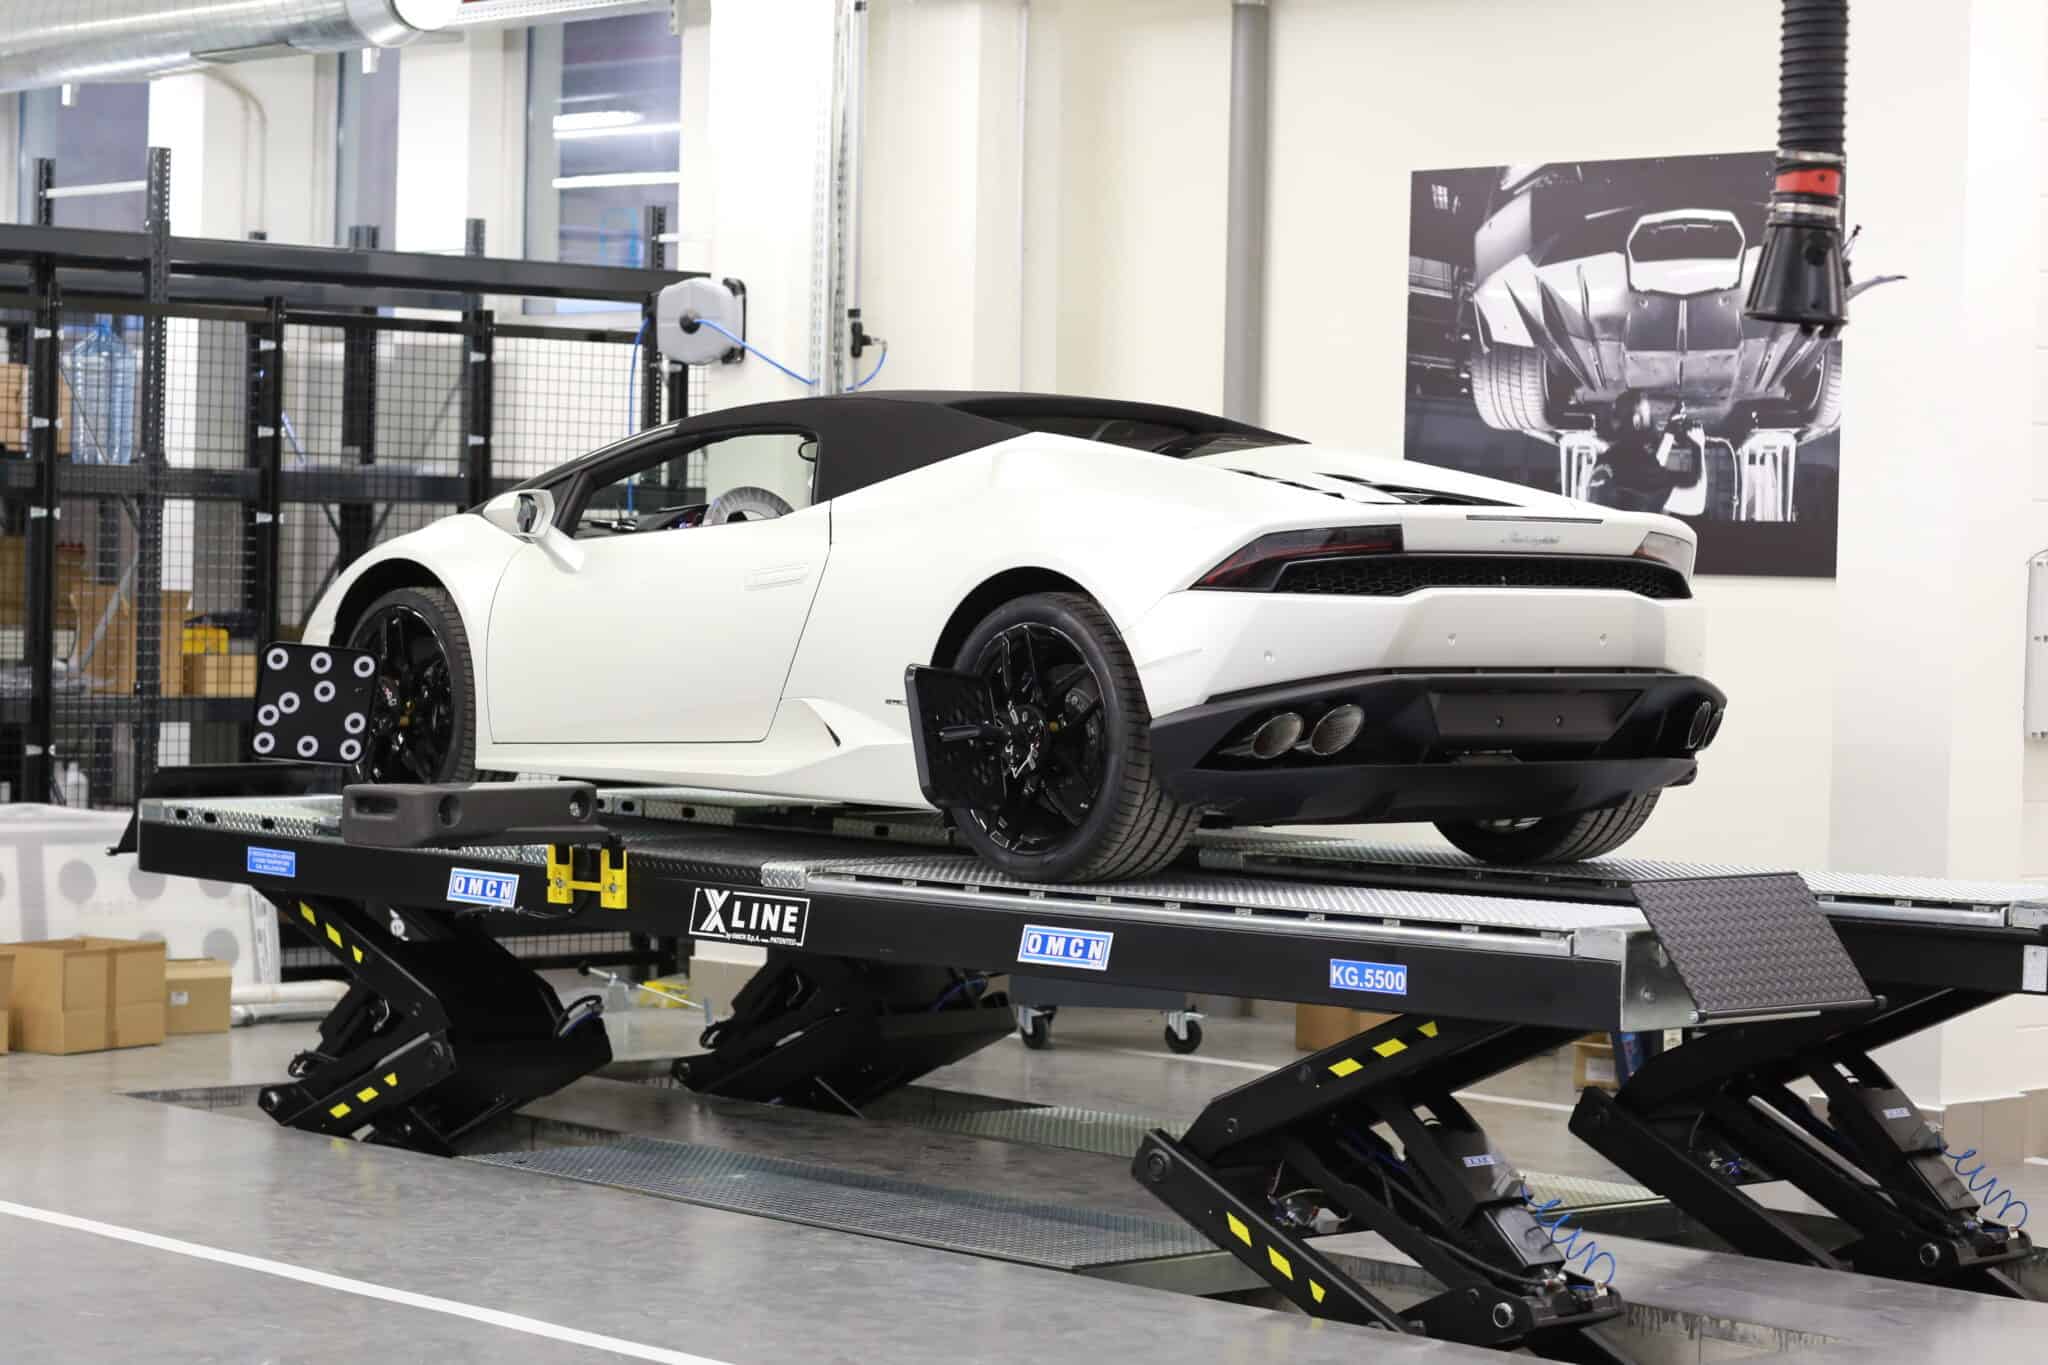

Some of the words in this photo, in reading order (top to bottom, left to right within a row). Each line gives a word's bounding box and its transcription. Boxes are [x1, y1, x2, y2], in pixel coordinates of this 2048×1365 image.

[454, 876, 512, 899] OMCN
[1028, 934, 1104, 961] OMCN
[1332, 965, 1404, 991] KG.5500
